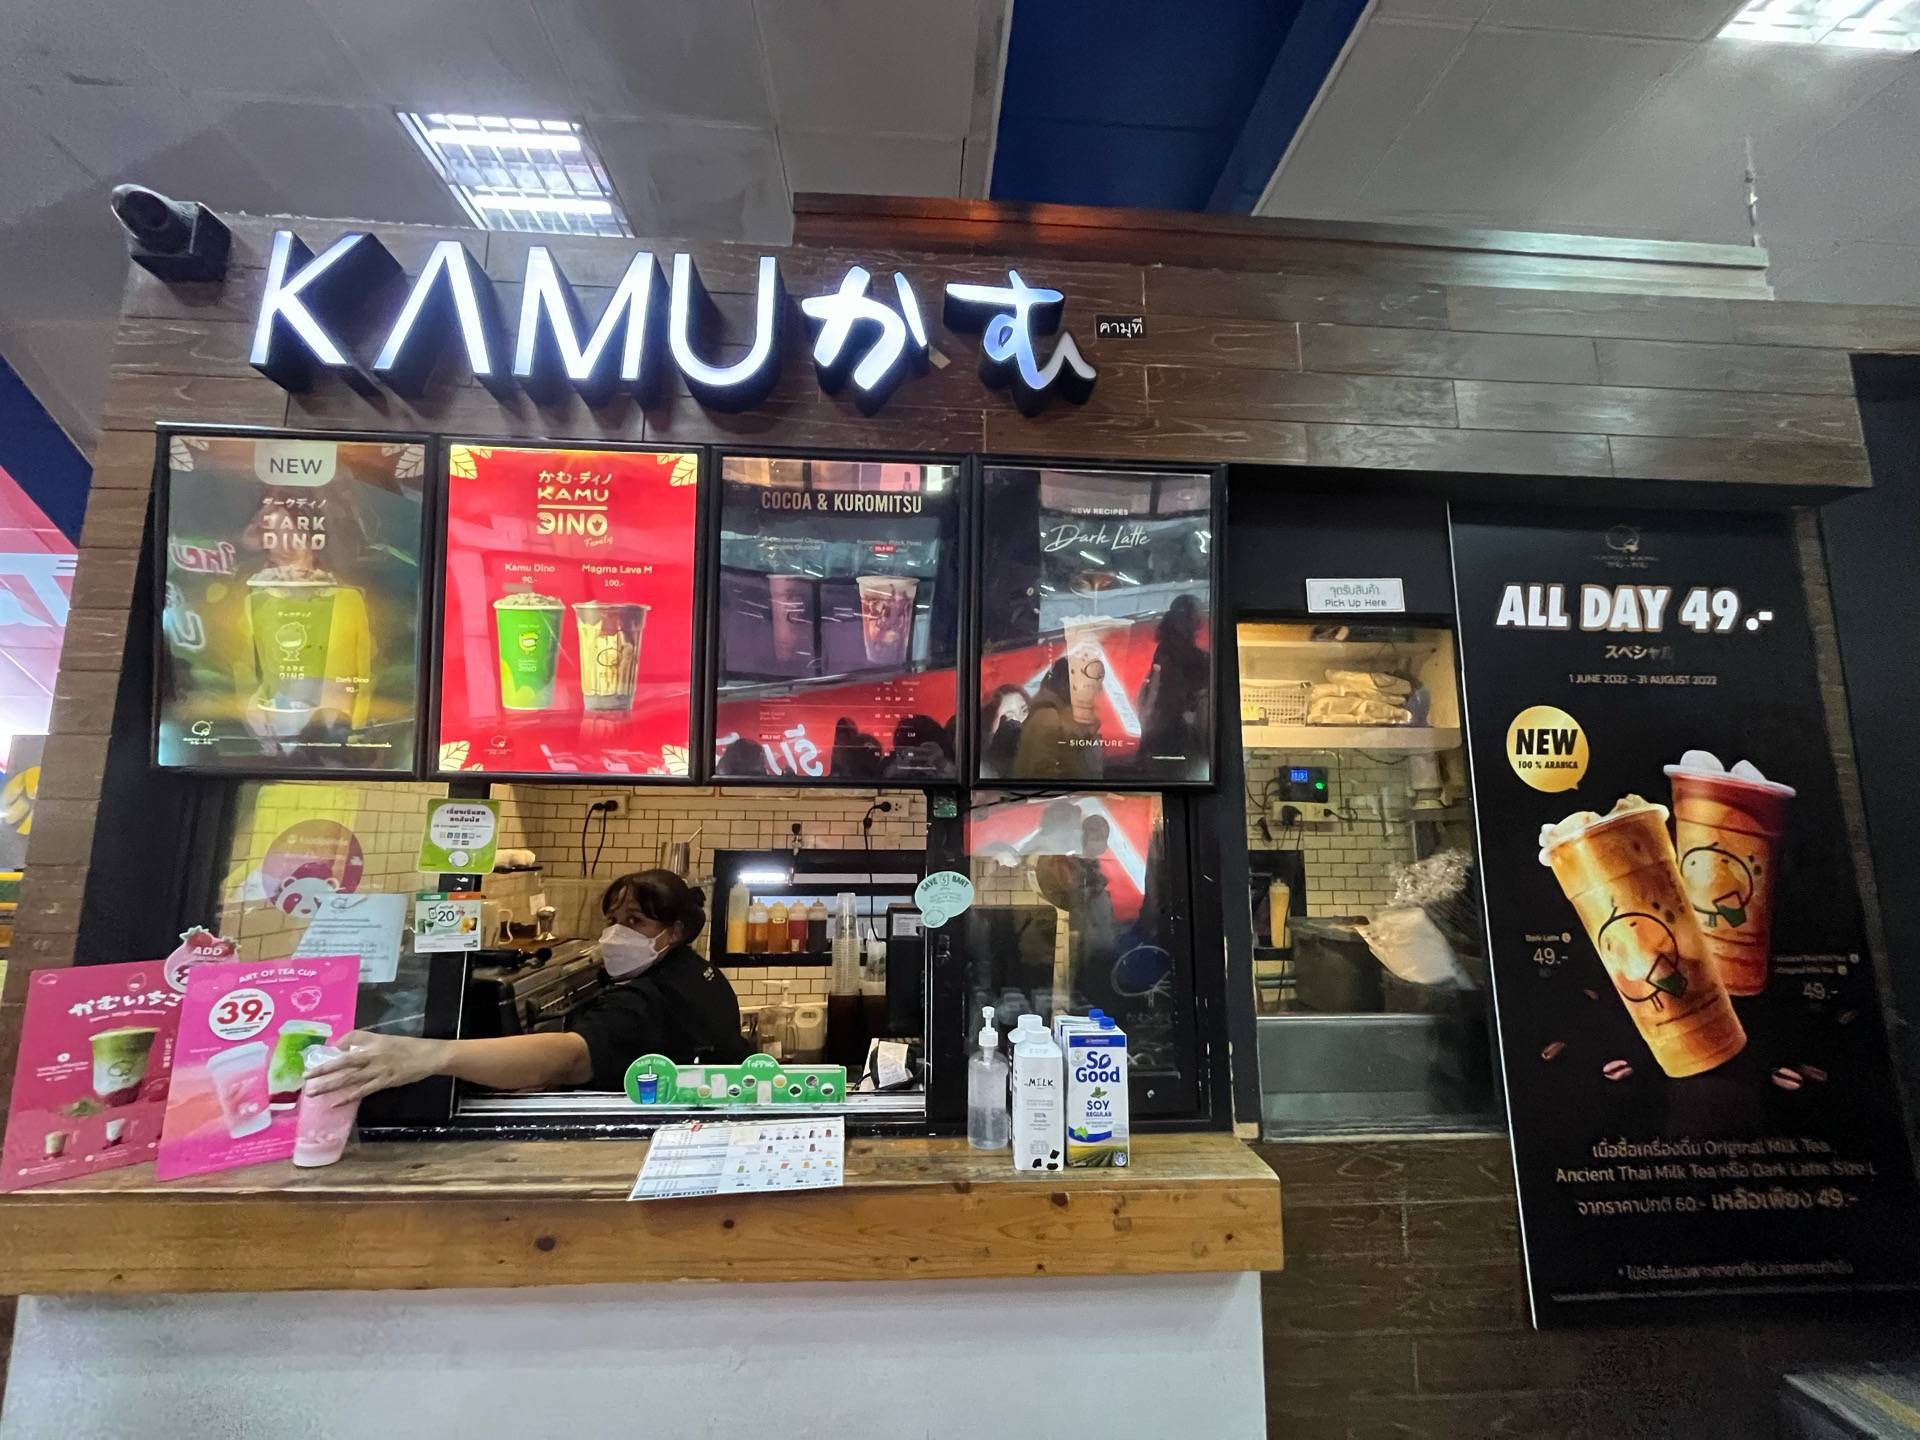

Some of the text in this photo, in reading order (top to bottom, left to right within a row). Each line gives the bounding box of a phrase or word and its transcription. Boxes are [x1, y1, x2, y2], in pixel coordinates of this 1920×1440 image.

[249, 230, 778, 388] KAMU
[801, 265, 1097, 391] かむ
[1099, 317, 1143, 339] คามุที
[270, 458, 322, 475] NEW
[537, 487, 609, 503] KAMU
[762, 491, 922, 513] COCOA & KUROMITSU
[1093, 508, 1129, 516] RECIPES
[263, 533, 326, 550] DINO
[1044, 524, 1151, 552] Dark Latte
[505, 563, 555, 573] Kamu Dino
[582, 564, 653, 575] Magma Lava M
[1325, 599, 1387, 608] Pick Up Here
[1496, 585, 1568, 628] ALL
[1582, 586, 1670, 630] DAY
[1575, 674, 1601, 684] JUNE
[1603, 675, 1629, 684] 2022
[1650, 675, 1691, 685] AUGUST
[1692, 675, 1718, 685] 2022
[1069, 739, 1123, 747] SIGNATURE
[1516, 729, 1578, 755] NEW
[921, 877, 938, 892] SAVE
[438, 910, 455, 922] 20
[192, 946, 224, 956] ADD
[238, 971, 258, 984] ART
[260, 969, 276, 977] OF
[278, 967, 296, 976] TEA
[297, 968, 318, 977] CUP
[216, 998, 272, 1026] 39.-
[1086, 1050, 1112, 1070] So
[1028, 1078, 1054, 1087] MILK
[1075, 1066, 1121, 1083] Good
[1086, 1100, 1110, 1110] SOY
[1704, 1139, 1764, 1158] Original
[1801, 1138, 1831, 1153] Tea
[1556, 1166, 1615, 1183] Ancient
[1617, 1165, 1652, 1181] Thai
[1655, 1164, 1687, 1180] Milk
[1752, 1162, 1785, 1177] Dark
[1791, 1163, 1831, 1177] Latte
[1832, 1161, 1865, 1176] Size
